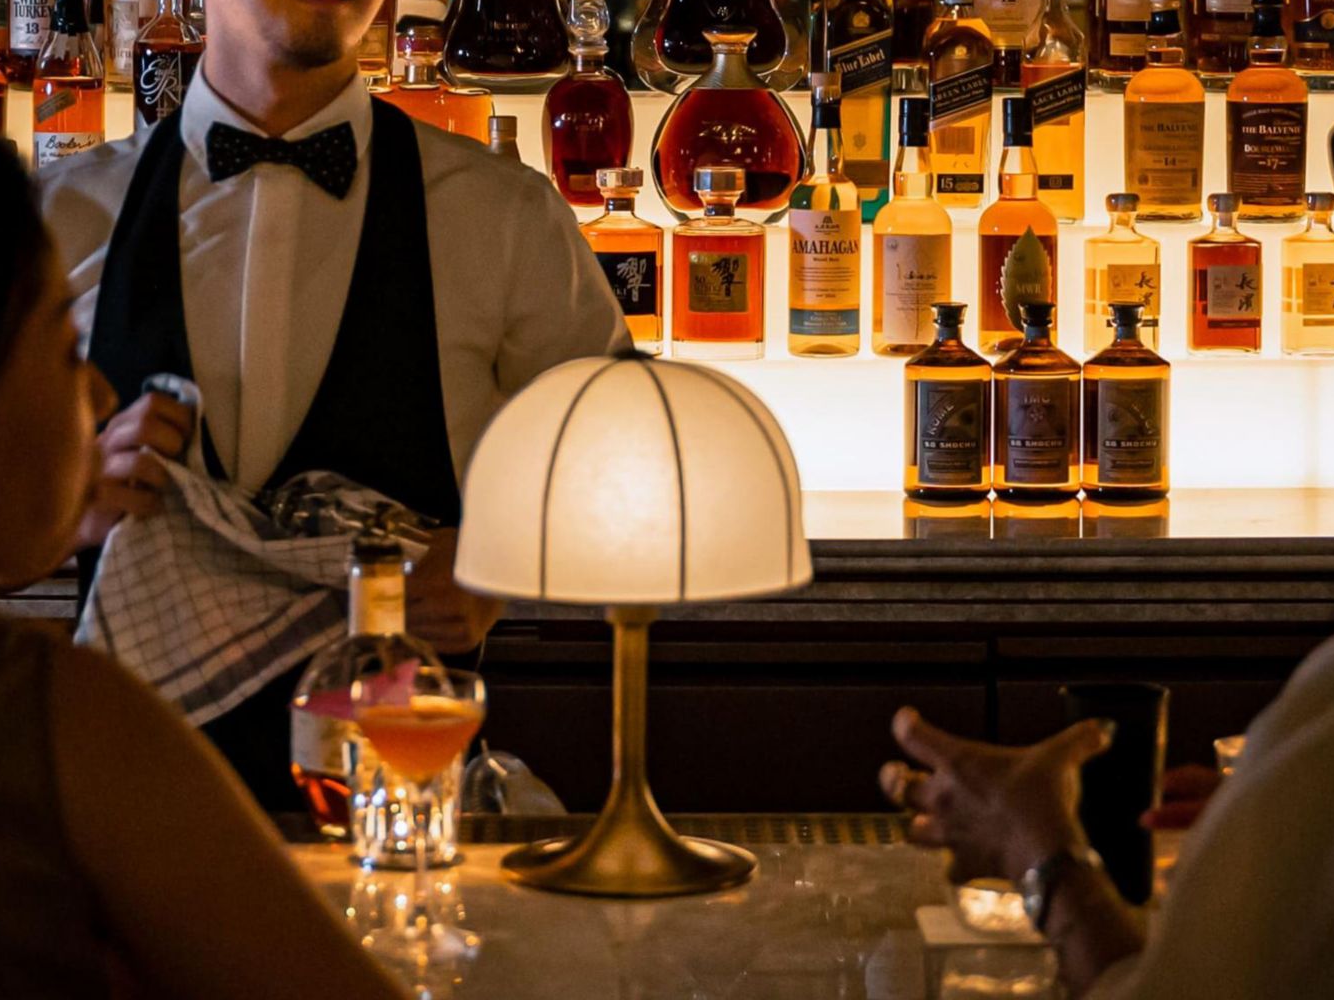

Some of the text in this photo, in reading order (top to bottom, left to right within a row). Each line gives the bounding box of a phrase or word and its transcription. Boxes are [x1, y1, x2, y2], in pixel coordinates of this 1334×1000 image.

[13, 2, 56, 19] TURKEY
[25, 22, 40, 34] 13
[940, 177, 954, 190] 15
[791, 240, 860, 255] AMAHAGAN
